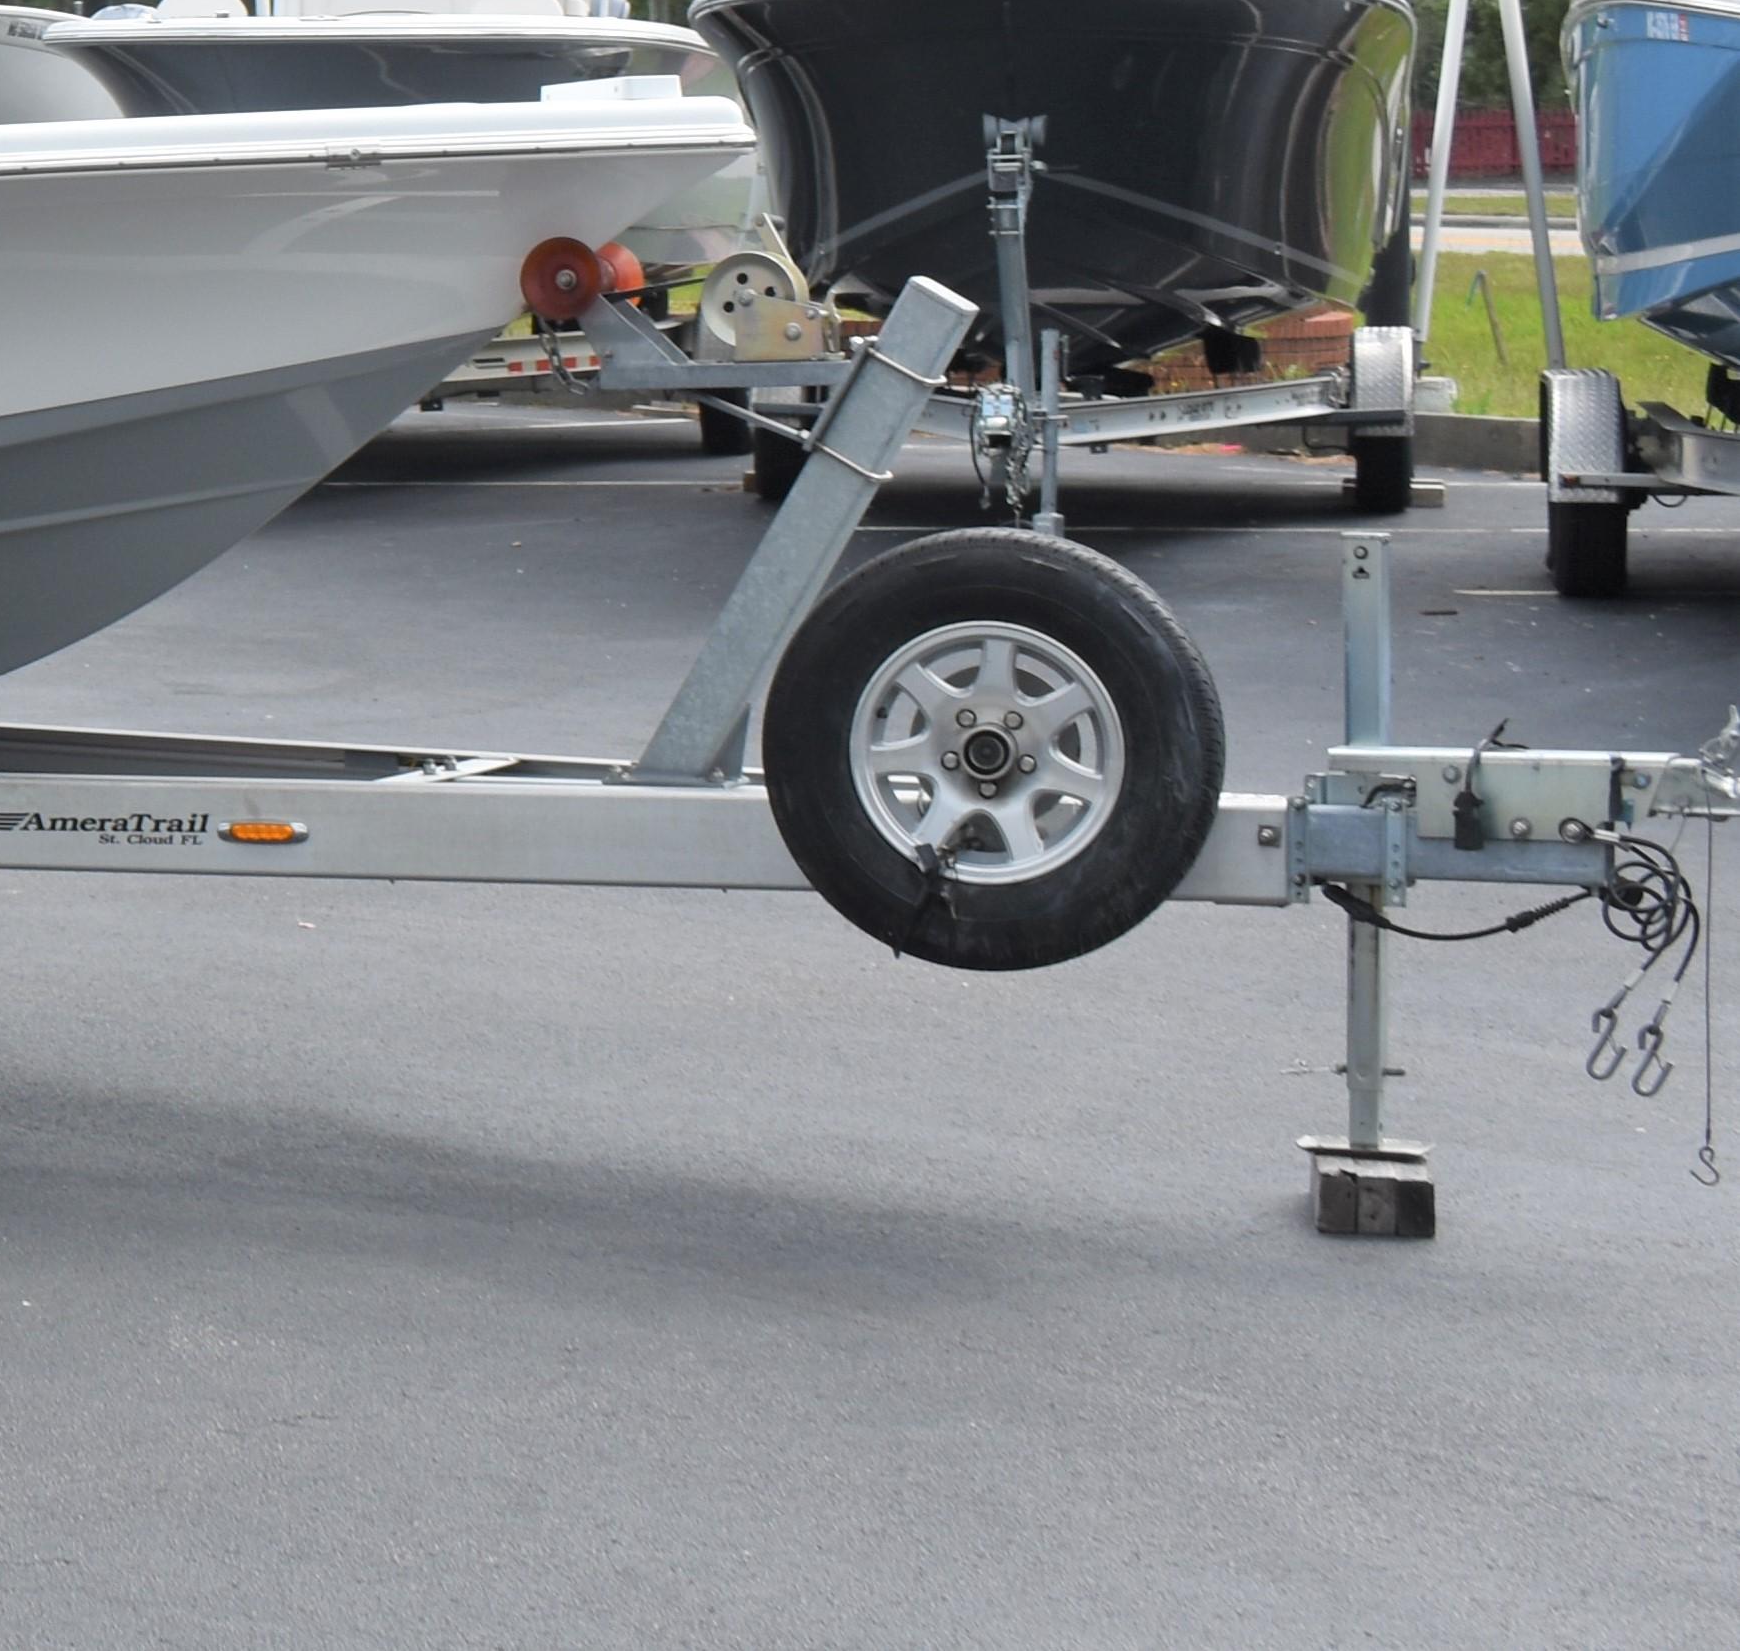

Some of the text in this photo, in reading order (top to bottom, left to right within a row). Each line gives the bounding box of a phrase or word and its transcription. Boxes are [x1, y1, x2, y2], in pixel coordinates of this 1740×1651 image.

[20, 812, 209, 833] AmeraTrail
[98, 833, 203, 845] St. Cloud FL
